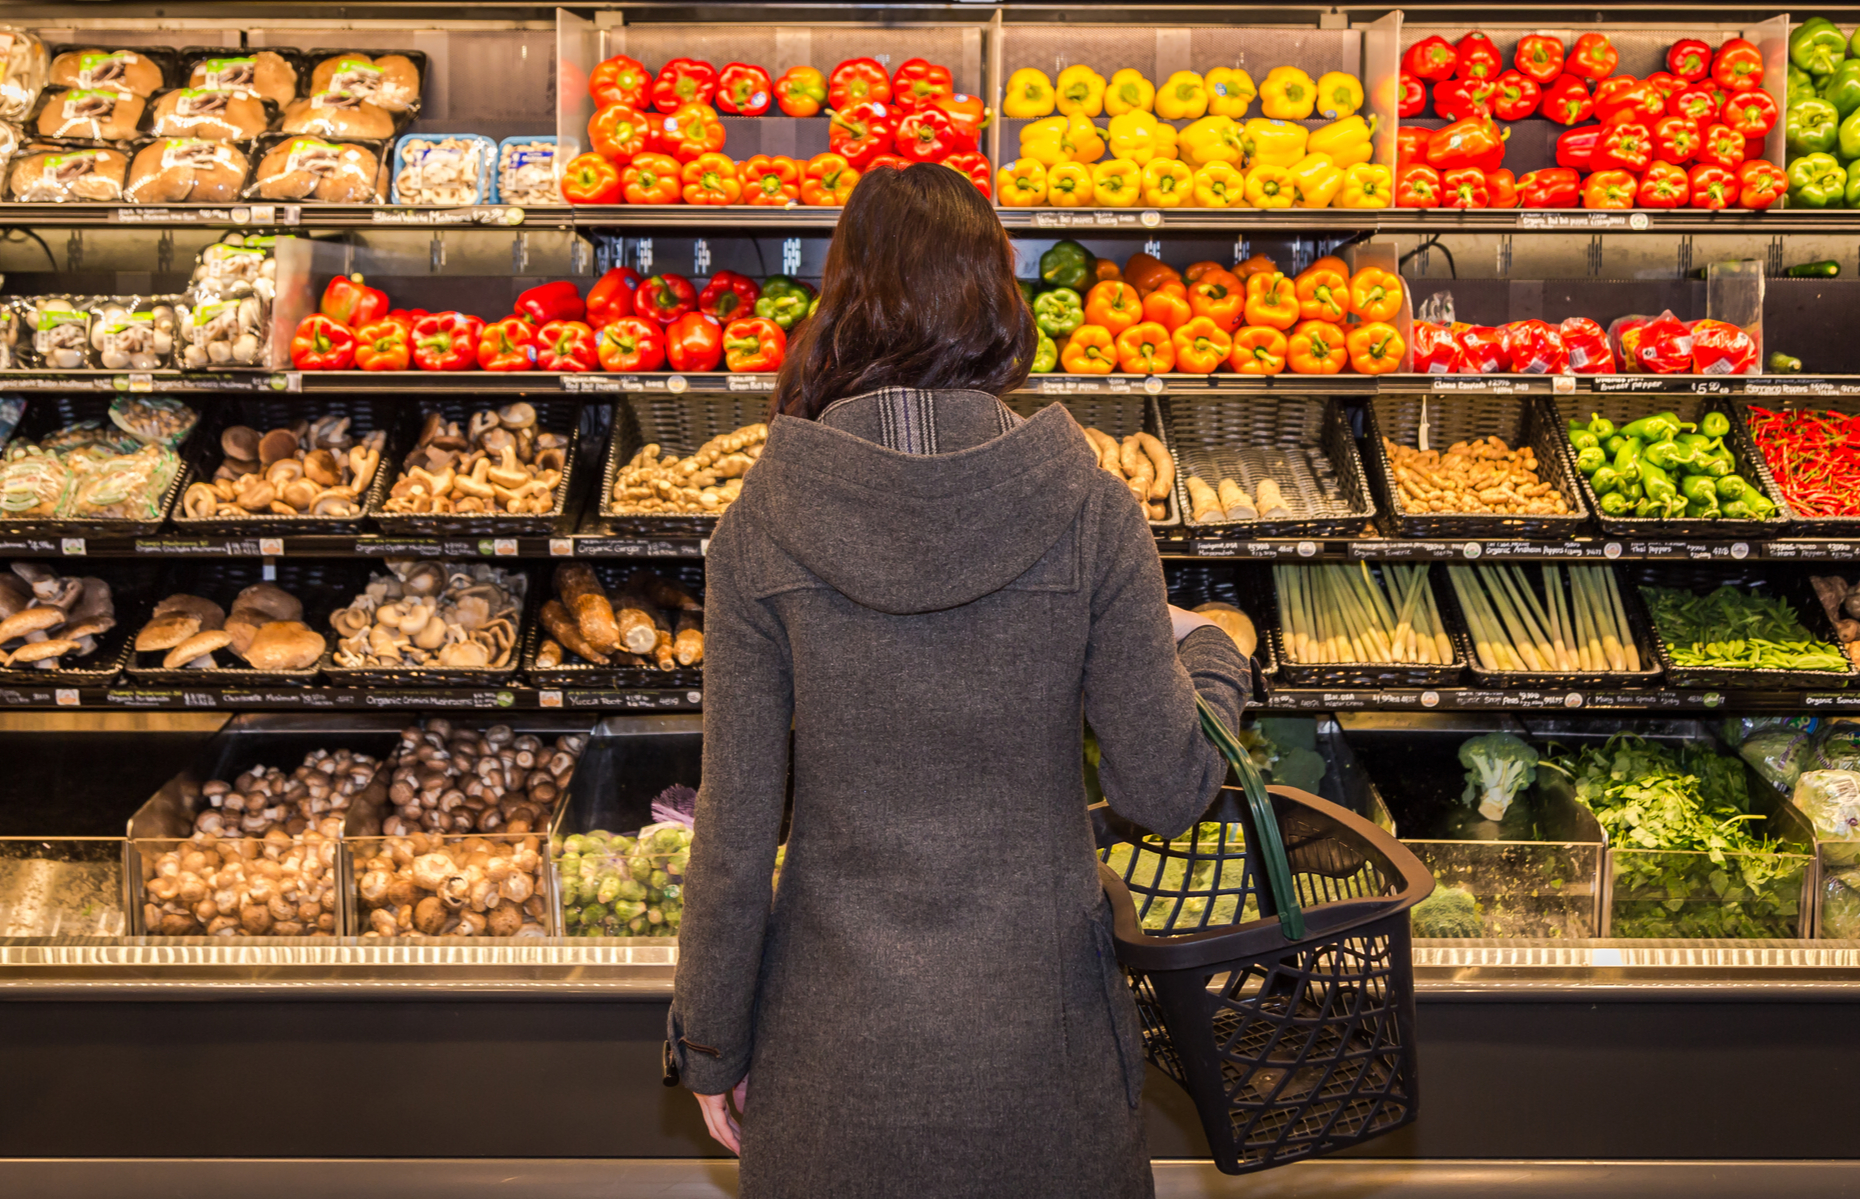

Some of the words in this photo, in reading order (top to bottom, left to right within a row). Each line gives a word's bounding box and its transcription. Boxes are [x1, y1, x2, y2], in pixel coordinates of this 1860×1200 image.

[577, 544, 613, 556] Organic
[1485, 546, 1511, 556] Organic
[1648, 546, 1672, 554] Peppers
[366, 695, 402, 707] Organic
[569, 696, 600, 706] Yucca
[600, 696, 623, 705] Root
[1502, 695, 1520, 706] Peas
[1805, 697, 1833, 706] Organic
